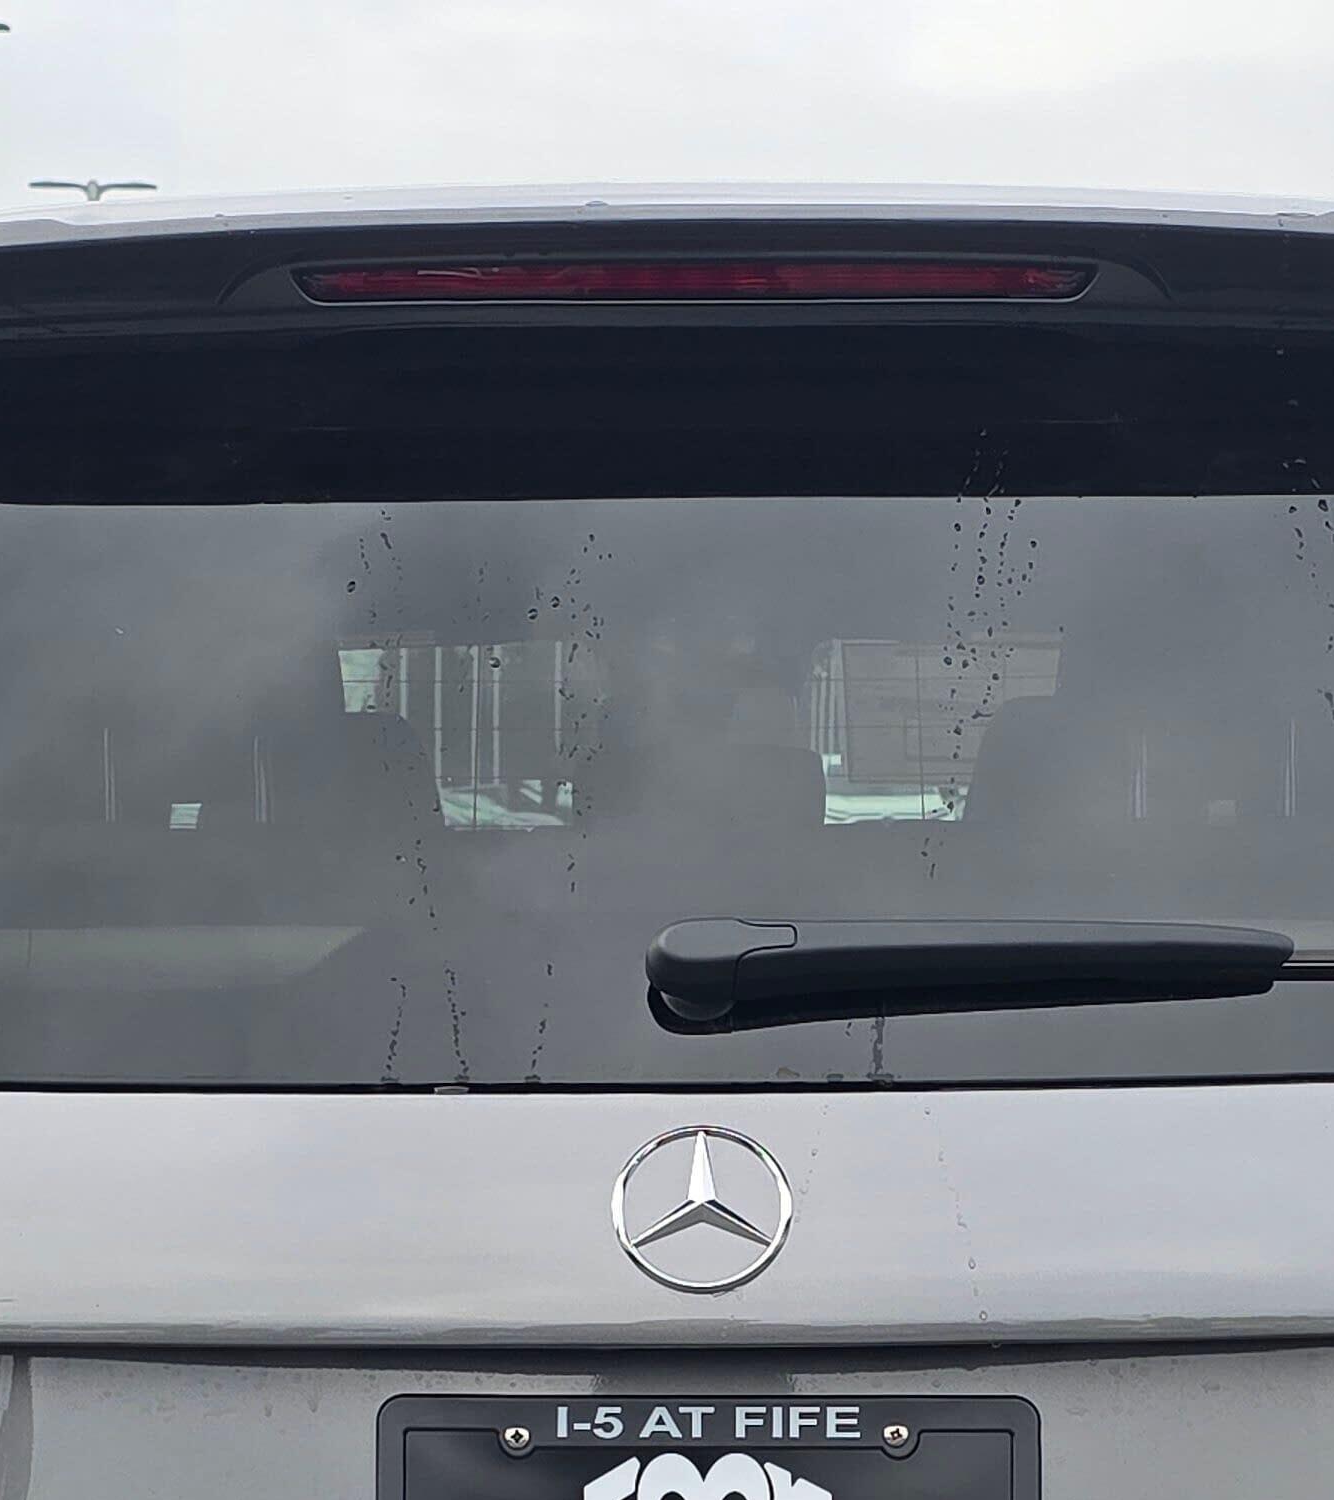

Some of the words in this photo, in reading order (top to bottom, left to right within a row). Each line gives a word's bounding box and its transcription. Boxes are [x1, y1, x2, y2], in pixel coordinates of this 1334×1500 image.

[556, 1406, 624, 1438] I-5
[640, 1406, 715, 1438] AT
[734, 1406, 862, 1438] FIFE
